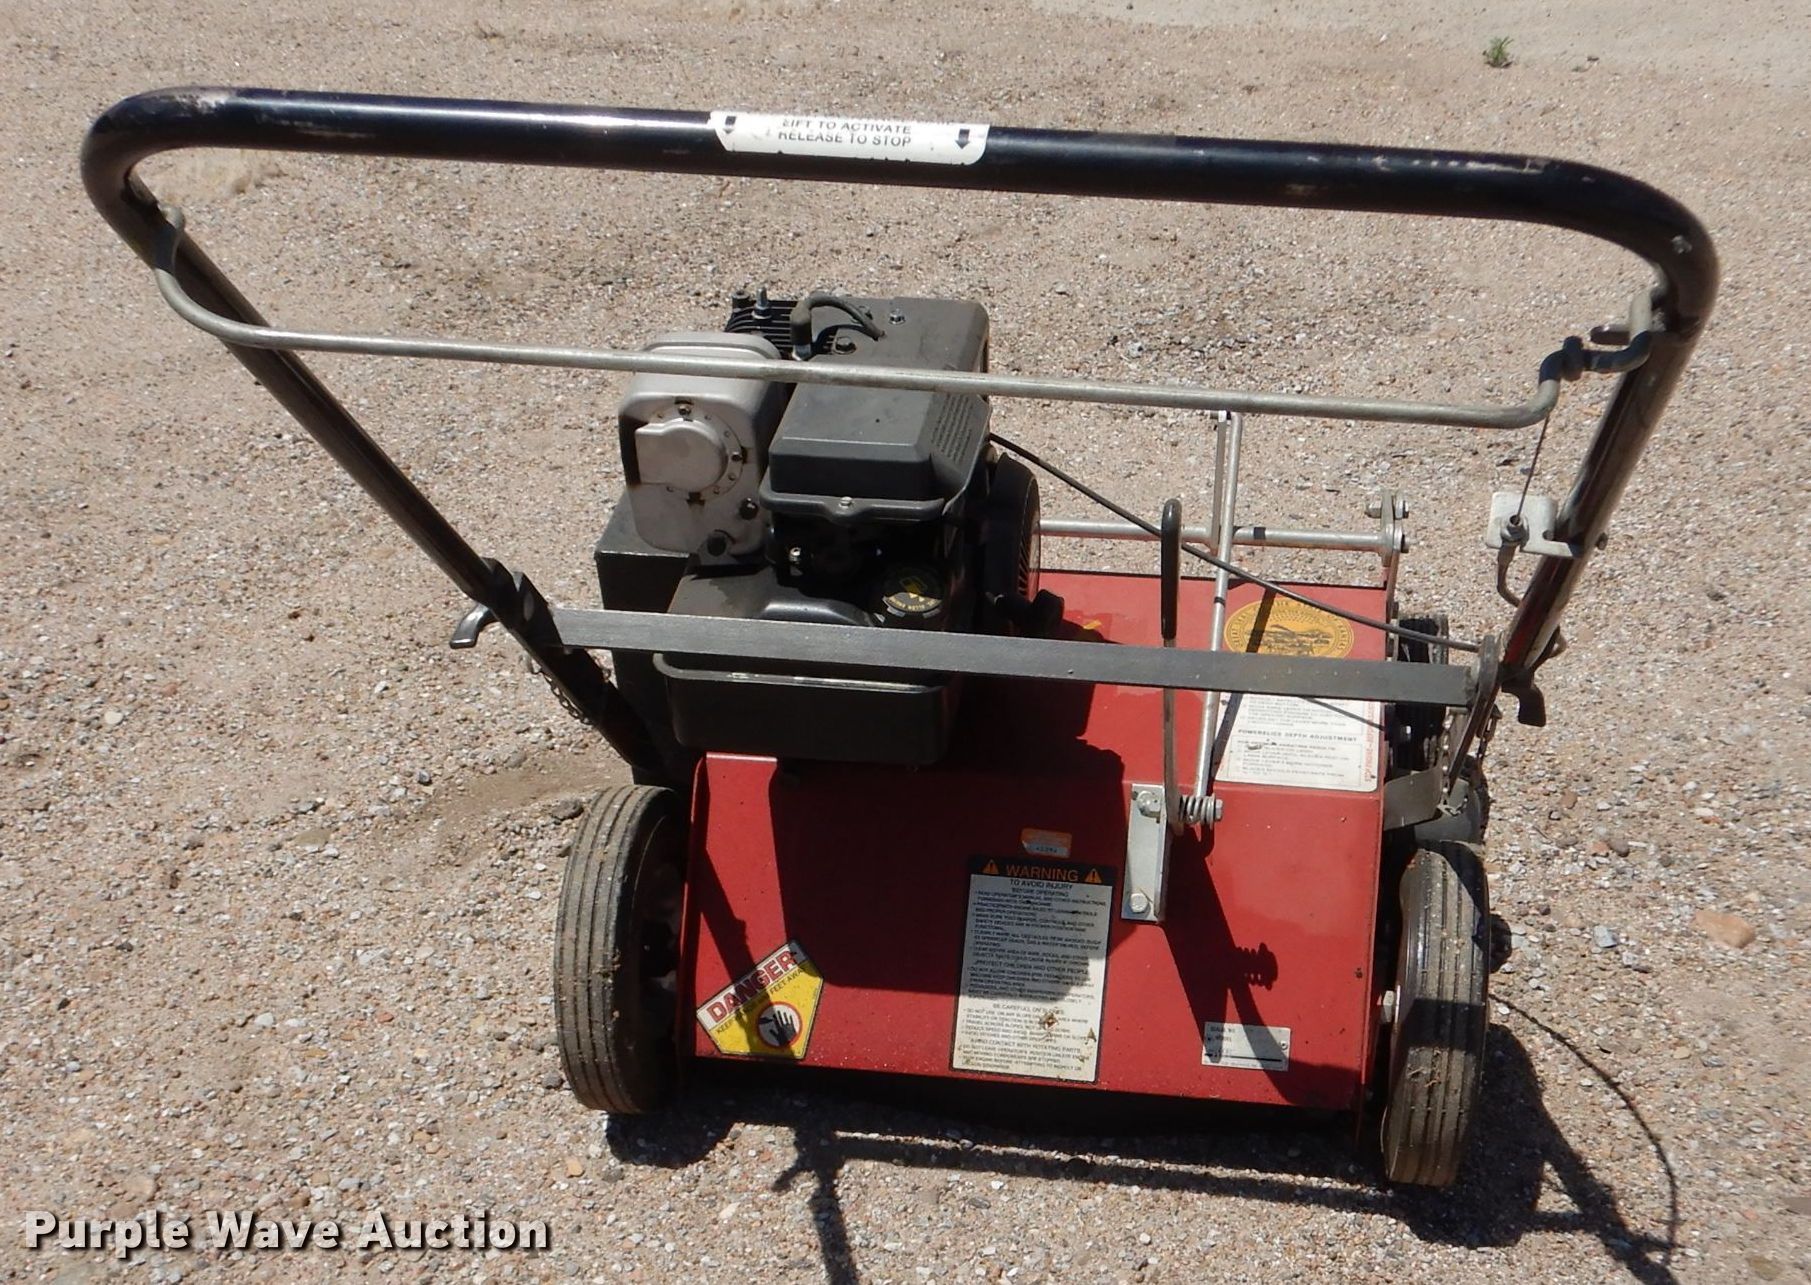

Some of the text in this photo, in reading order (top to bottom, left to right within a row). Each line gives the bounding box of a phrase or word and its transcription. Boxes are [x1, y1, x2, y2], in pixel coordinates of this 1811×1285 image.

[819, 121, 837, 130] TO
[841, 122, 912, 135] ACTIVATE
[778, 132, 912, 147] RELEASE TO STOP
[1006, 864, 1079, 882] WARNING
[1021, 880, 1043, 888] AVOID
[706, 951, 798, 1022] DANGER
[770, 981, 787, 995] FEET
